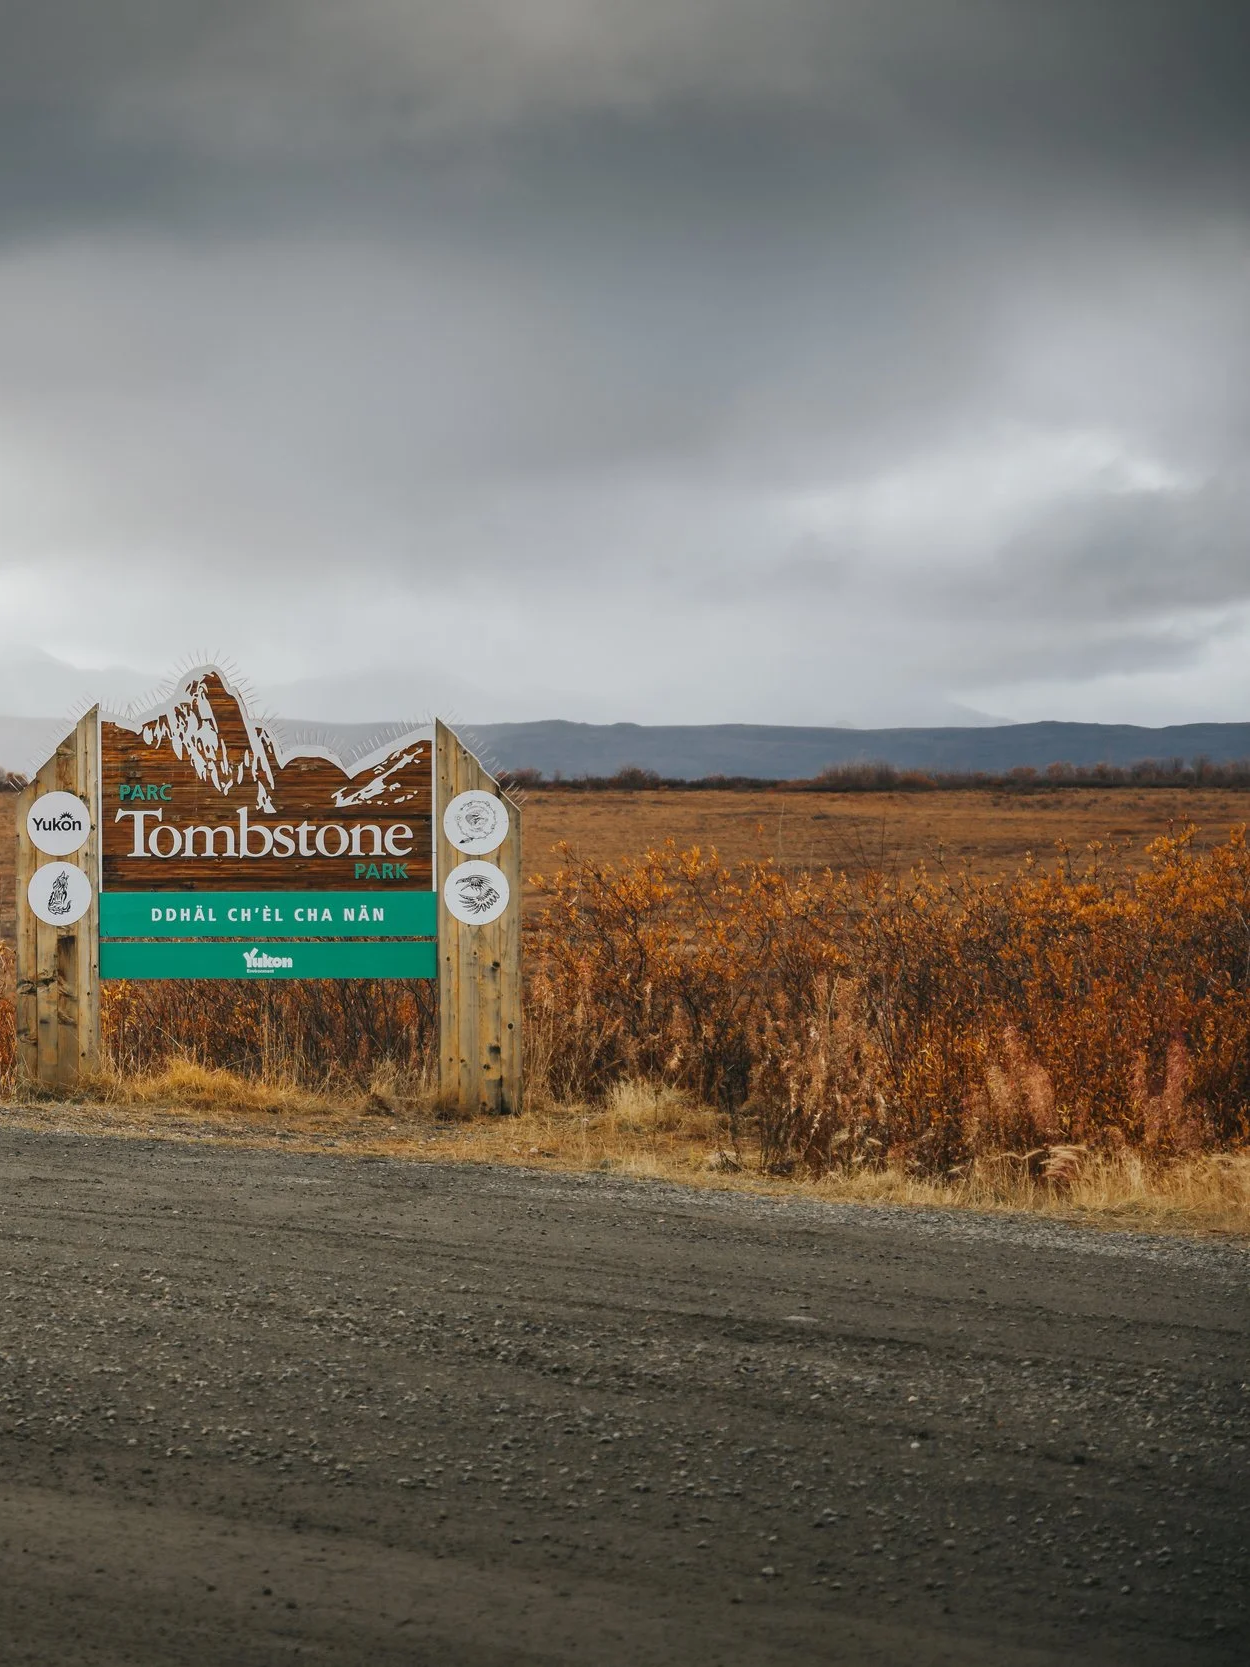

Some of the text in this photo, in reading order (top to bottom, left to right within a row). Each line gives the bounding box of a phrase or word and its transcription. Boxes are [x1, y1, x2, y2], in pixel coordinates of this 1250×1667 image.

[119, 784, 172, 801] PARC
[32, 817, 82, 831] Yukon
[114, 806, 414, 859] Tombstone
[354, 863, 409, 880] PARK
[151, 905, 217, 922] DDHÄL
[294, 908, 333, 922] CHA
[343, 905, 385, 922] NÄN
[243, 947, 293, 968] Yukon
